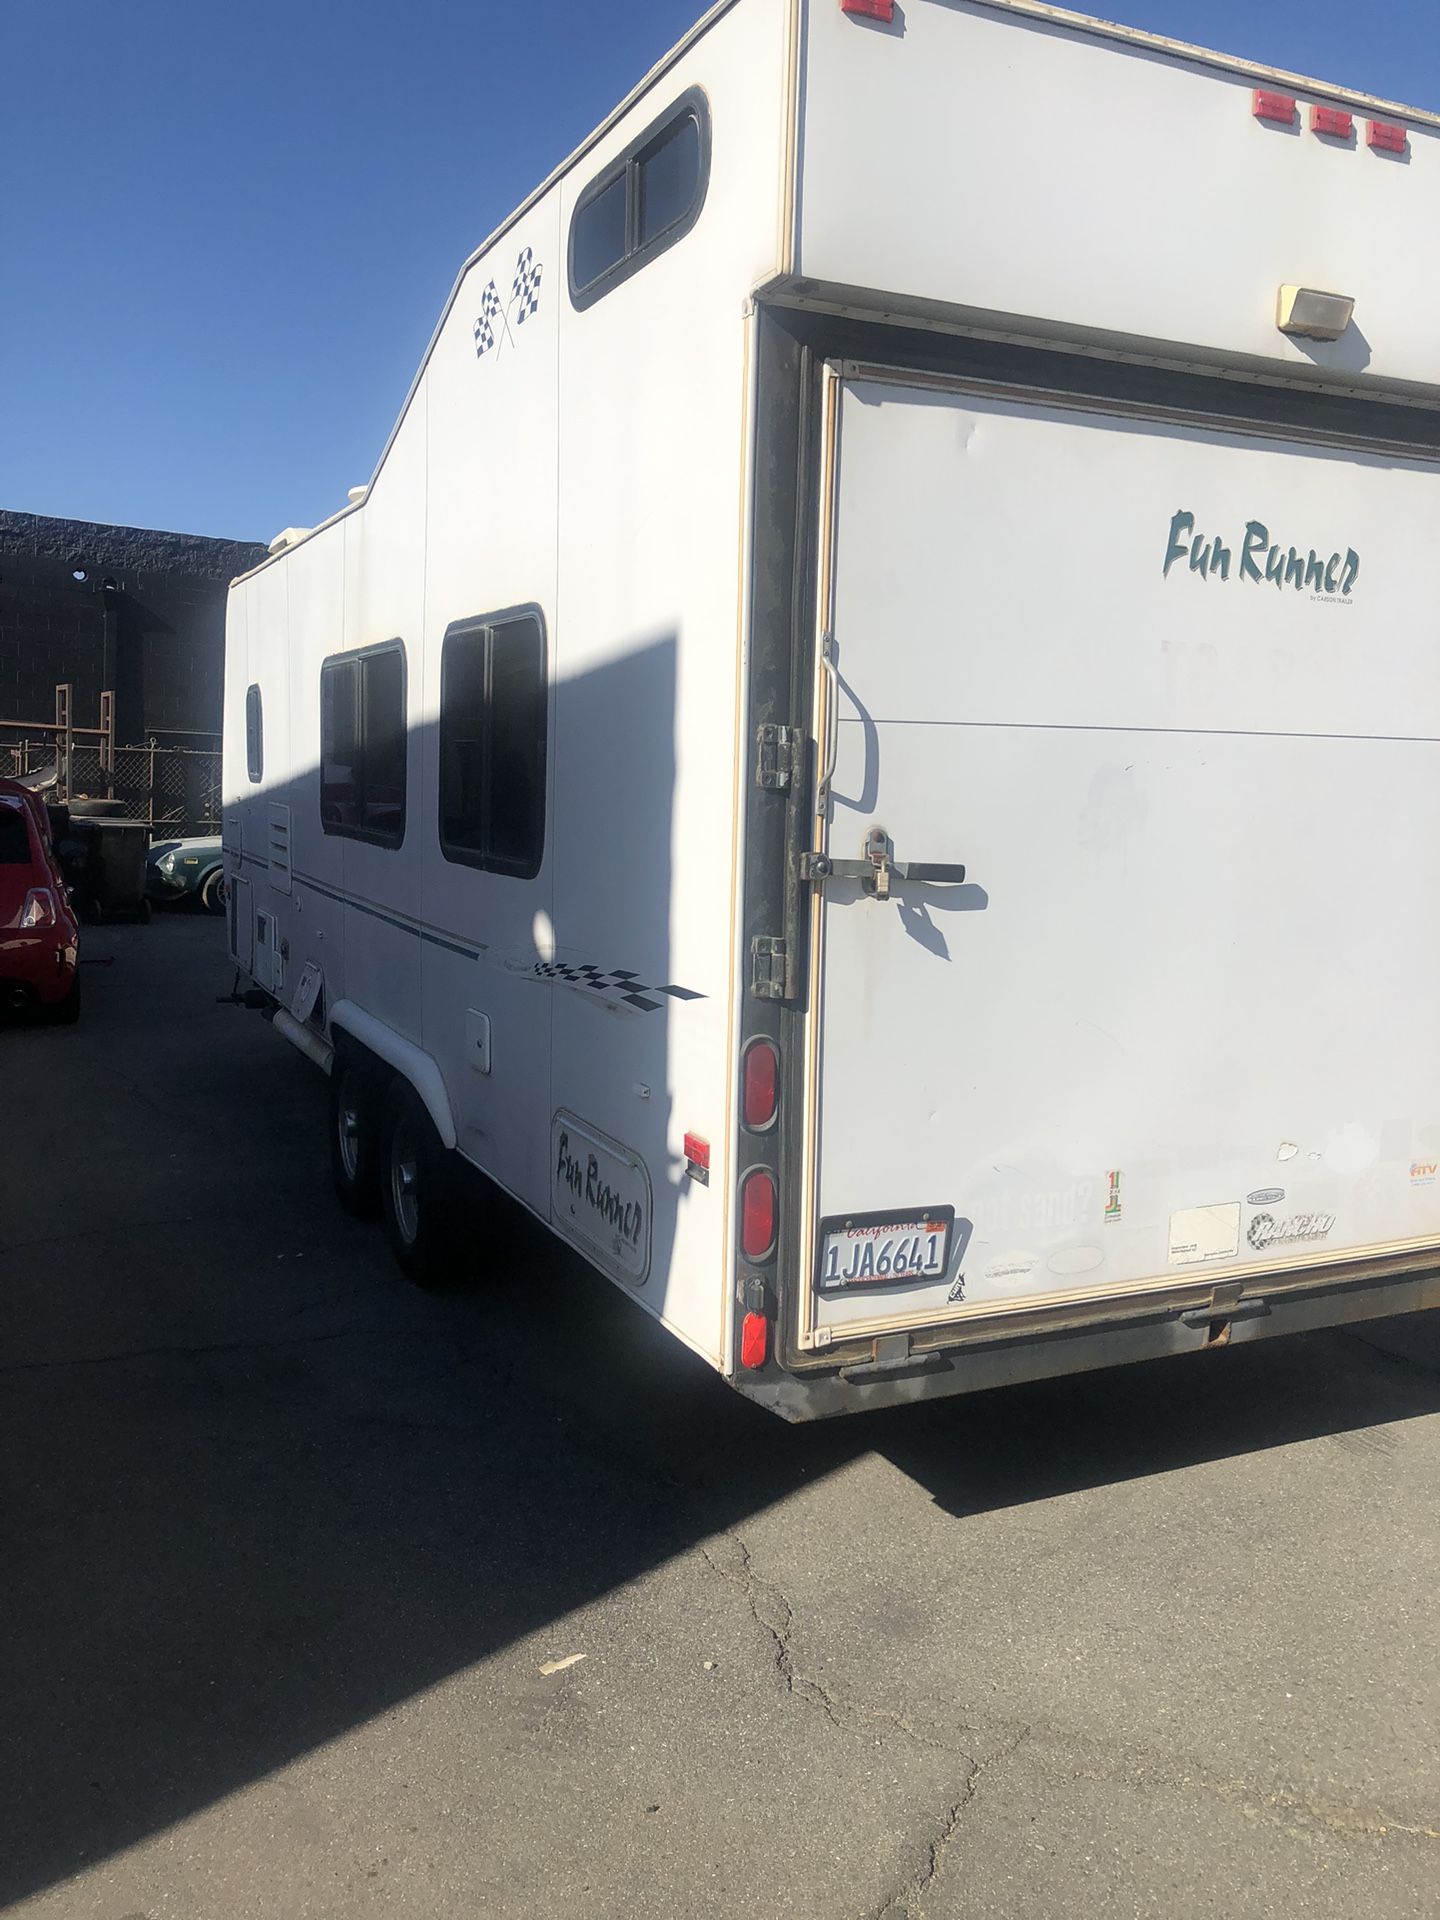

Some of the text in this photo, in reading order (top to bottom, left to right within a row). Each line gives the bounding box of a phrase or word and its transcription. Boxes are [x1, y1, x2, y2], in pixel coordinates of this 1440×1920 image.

[1162, 508, 1231, 581] Fun
[556, 1130, 583, 1198] Fun
[825, 1234, 939, 1281] 1JA6641
